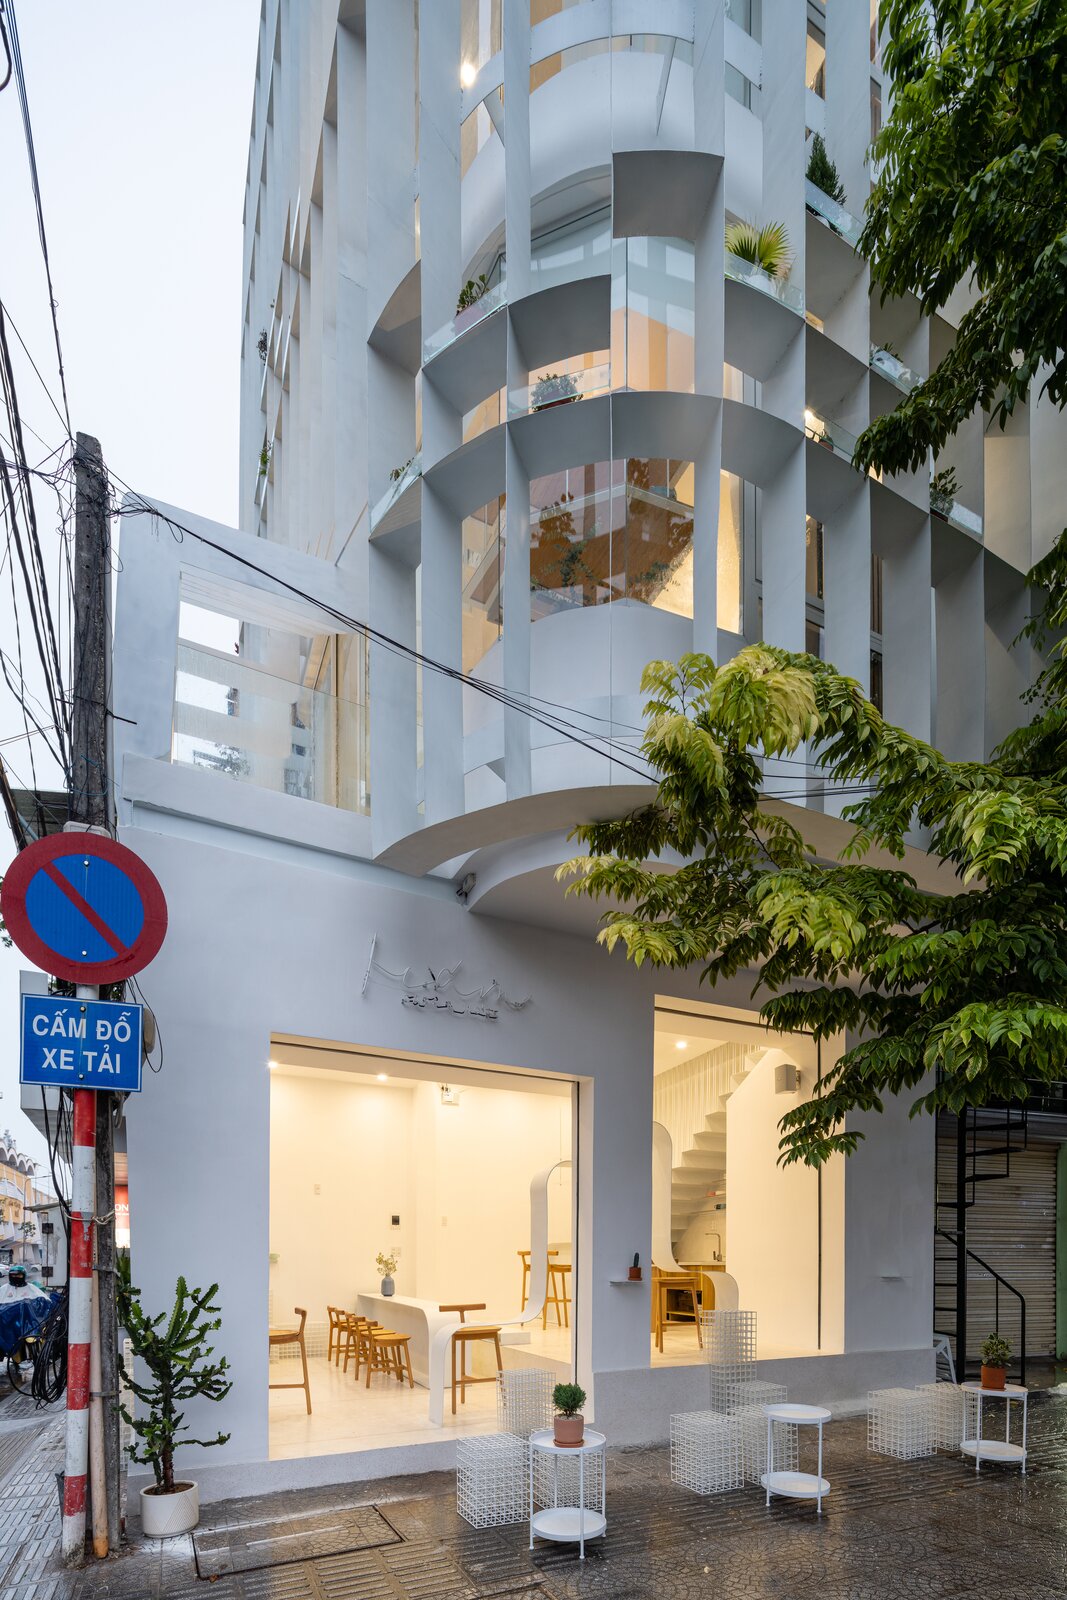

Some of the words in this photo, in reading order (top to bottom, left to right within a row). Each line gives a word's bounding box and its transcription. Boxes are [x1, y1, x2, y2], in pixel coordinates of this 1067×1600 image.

[33, 1008, 87, 1039] CẤM
[96, 1011, 131, 1043] ĐỖ
[41, 1047, 74, 1070] XE
[83, 1044, 121, 1074] TẢI
